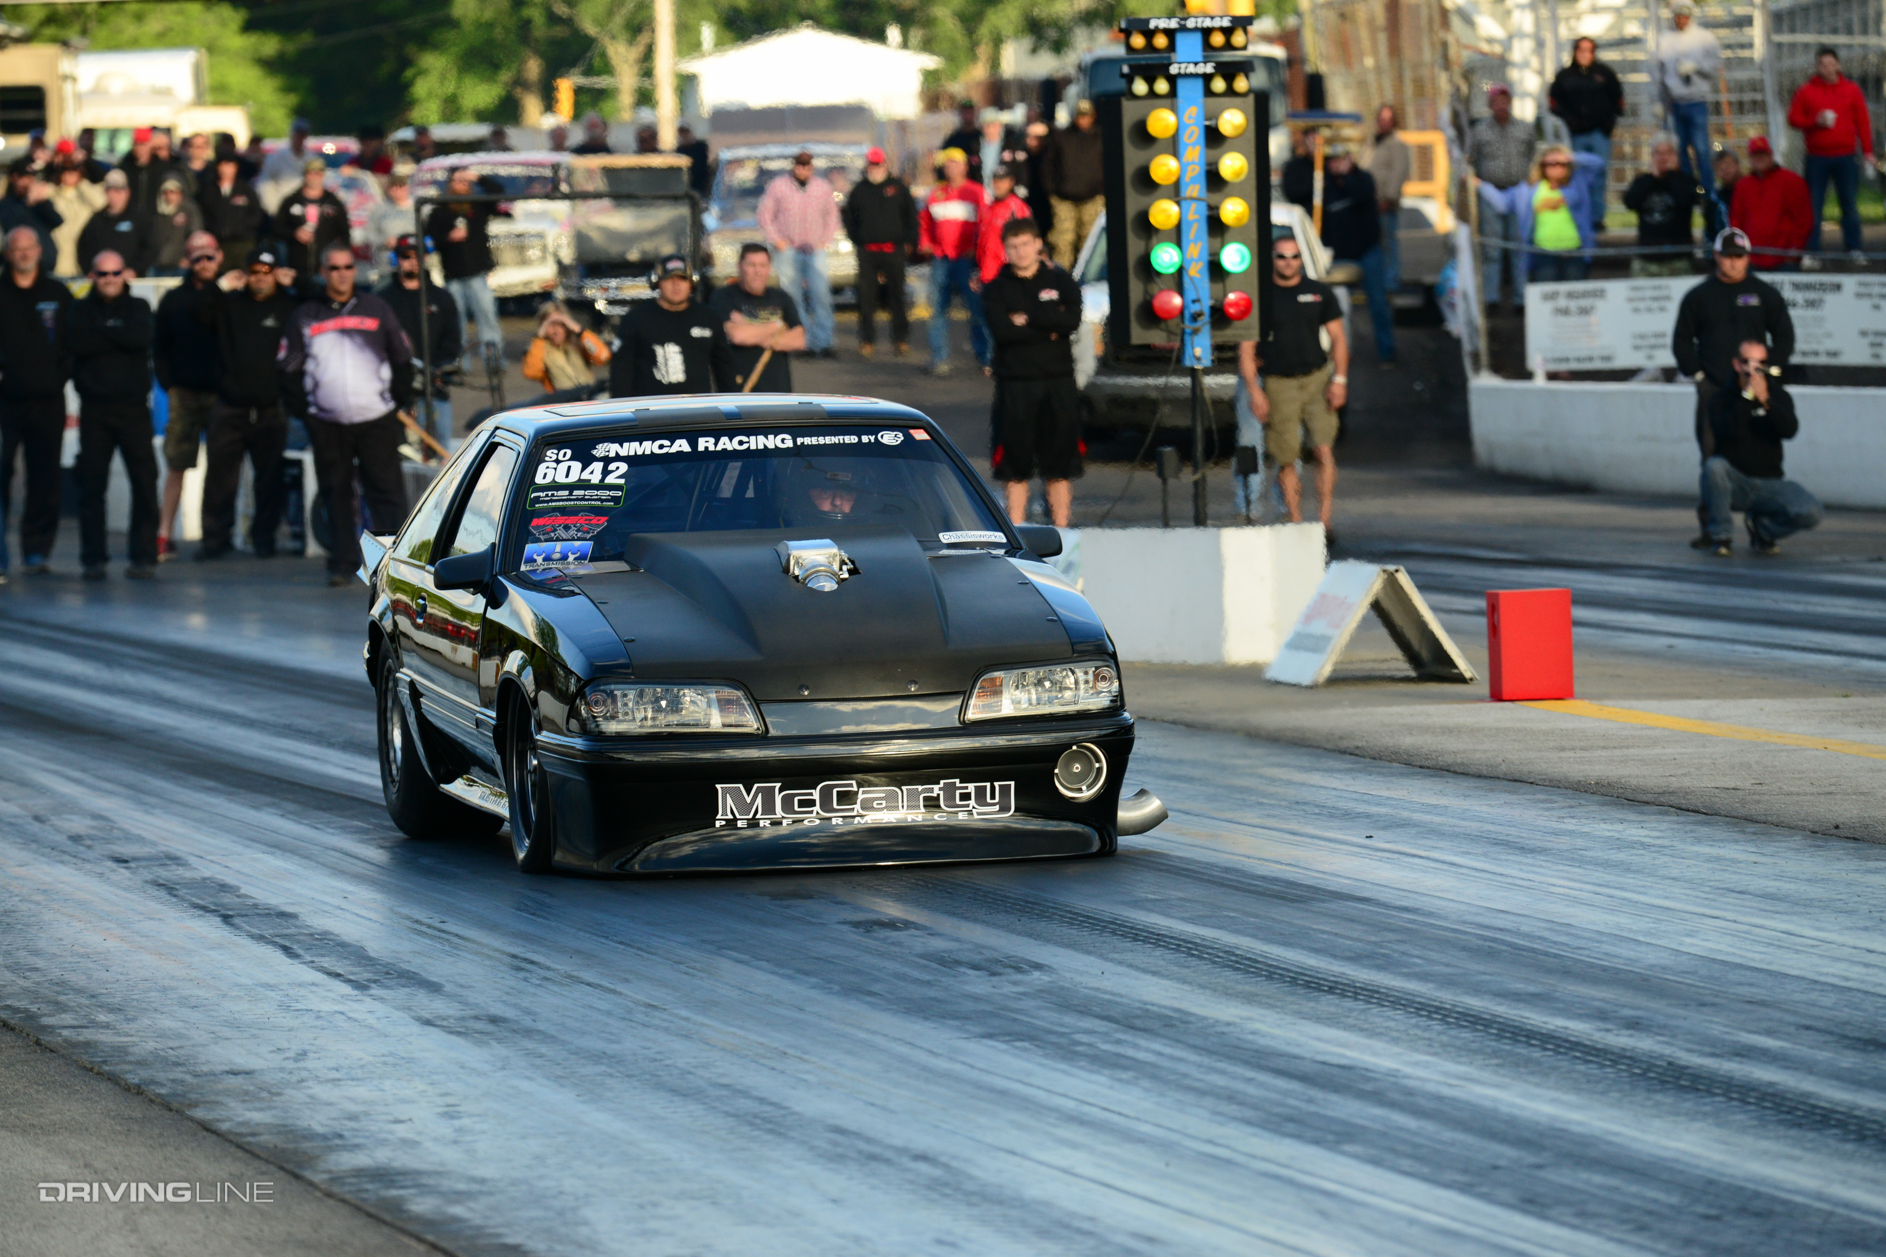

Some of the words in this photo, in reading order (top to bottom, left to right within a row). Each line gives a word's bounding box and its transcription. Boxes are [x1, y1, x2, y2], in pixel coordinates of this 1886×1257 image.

[1149, 16, 1232, 29] PRE-STAGE
[1169, 62, 1216, 75] STAGE
[1182, 105, 1203, 279] COMPULINK
[609, 438, 691, 457] NMCA
[698, 434, 794, 451] RACING
[796, 435, 859, 446] PRESENTED
[861, 434, 876, 444] BY
[544, 448, 572, 461] SO
[534, 461, 628, 484] 6042
[531, 490, 569, 498] AMS
[524, 560, 586, 569] TRANSMISSION
[715, 779, 1016, 819] McCarty
[715, 812, 969, 828] PERFORMANCE
